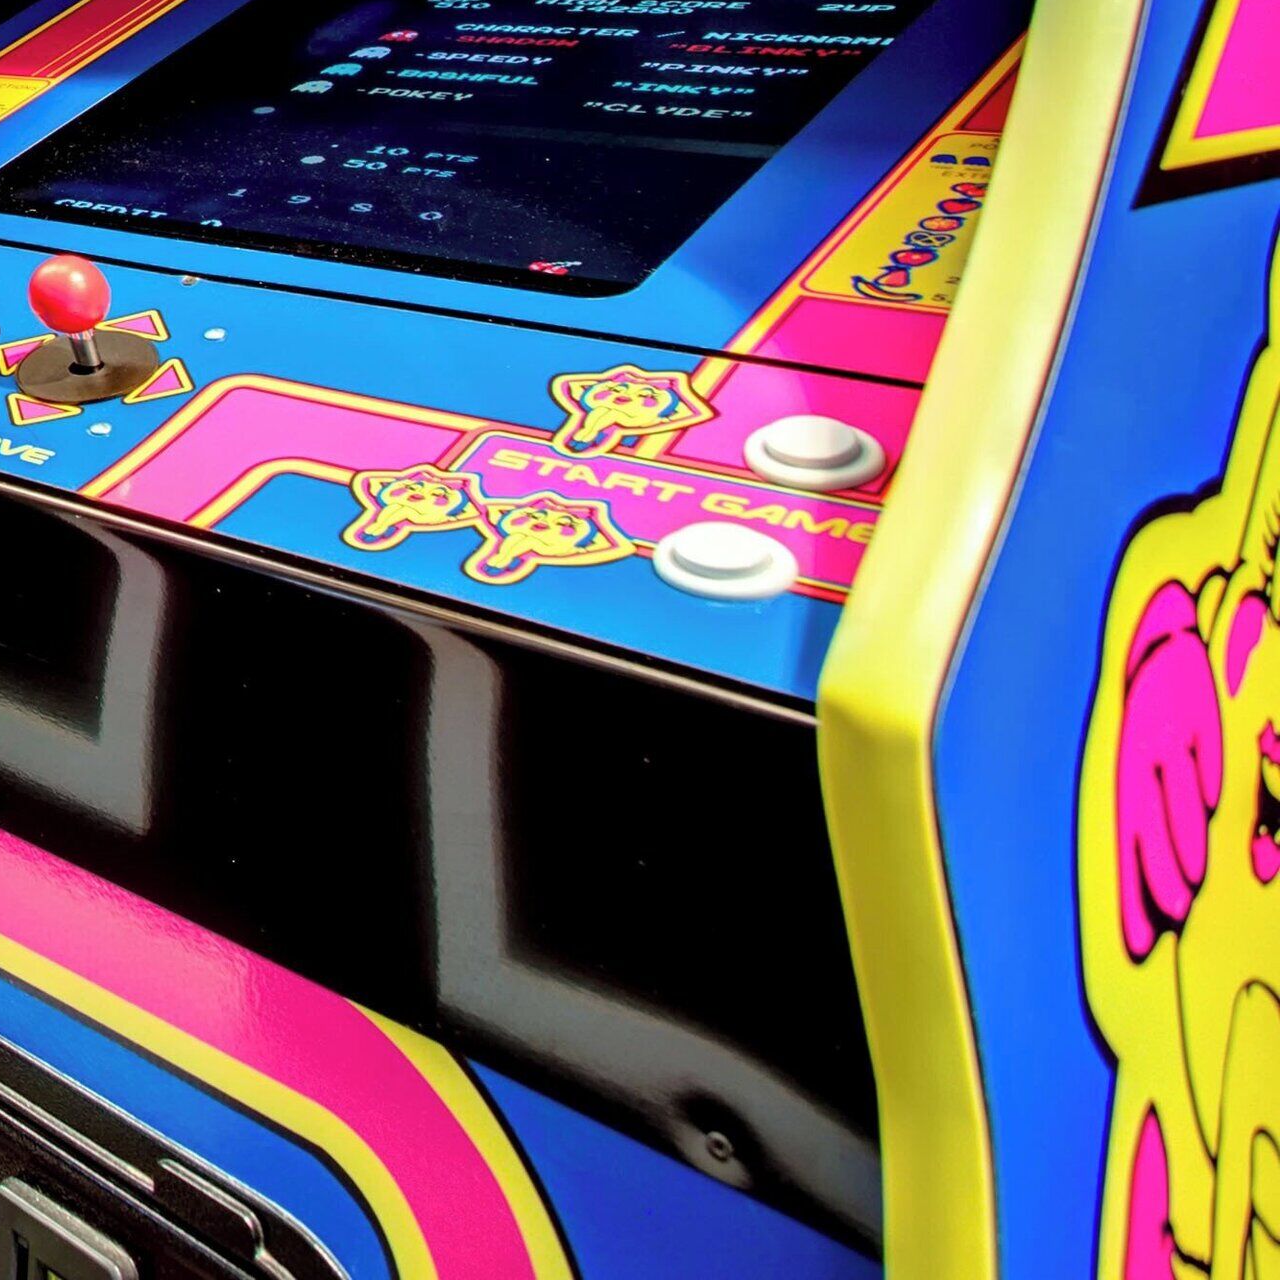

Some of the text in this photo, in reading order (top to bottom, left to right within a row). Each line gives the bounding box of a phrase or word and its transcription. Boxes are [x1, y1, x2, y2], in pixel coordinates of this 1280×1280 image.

[636, 0, 752, 10] SCORE
[815, 3, 897, 13] 2UP
[455, 23, 640, 38] CHARACTER
[366, 145, 479, 163] 10 PTS
[342, 158, 457, 178] 50 PTS
[487, 447, 879, 545] START GAME
